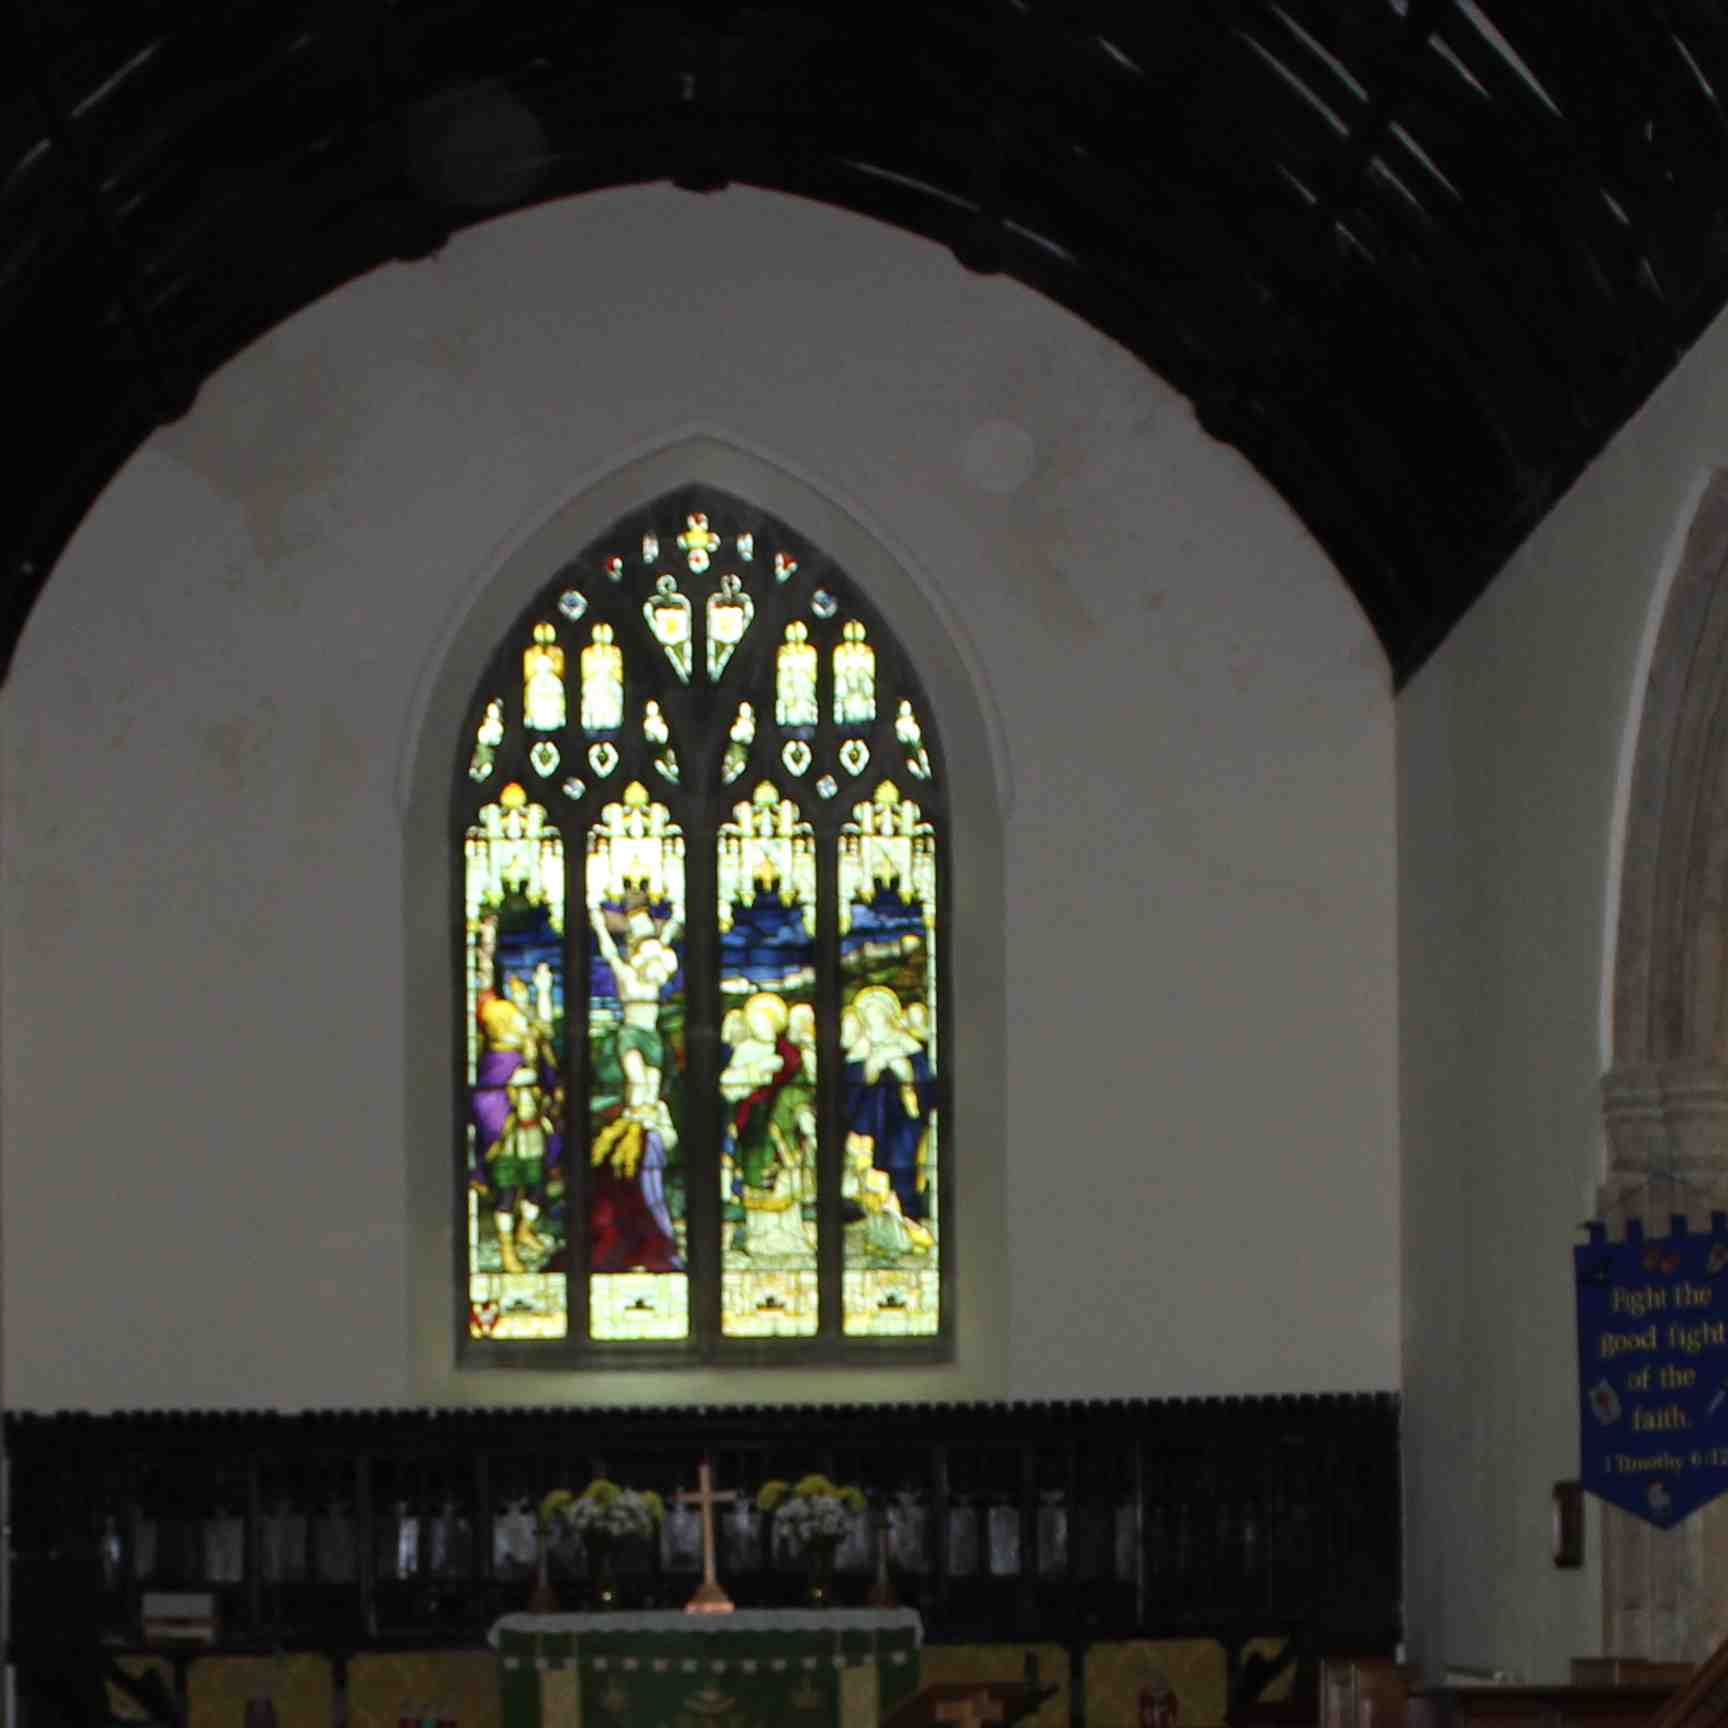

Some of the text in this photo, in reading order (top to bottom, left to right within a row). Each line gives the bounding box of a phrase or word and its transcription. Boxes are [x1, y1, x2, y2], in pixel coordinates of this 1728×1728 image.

[1612, 1280, 1713, 1318] Fight the
[1600, 1320, 1727, 1359] good fight
[1627, 1363, 1697, 1390] of the
[1615, 1451, 1684, 1478] Timothy
